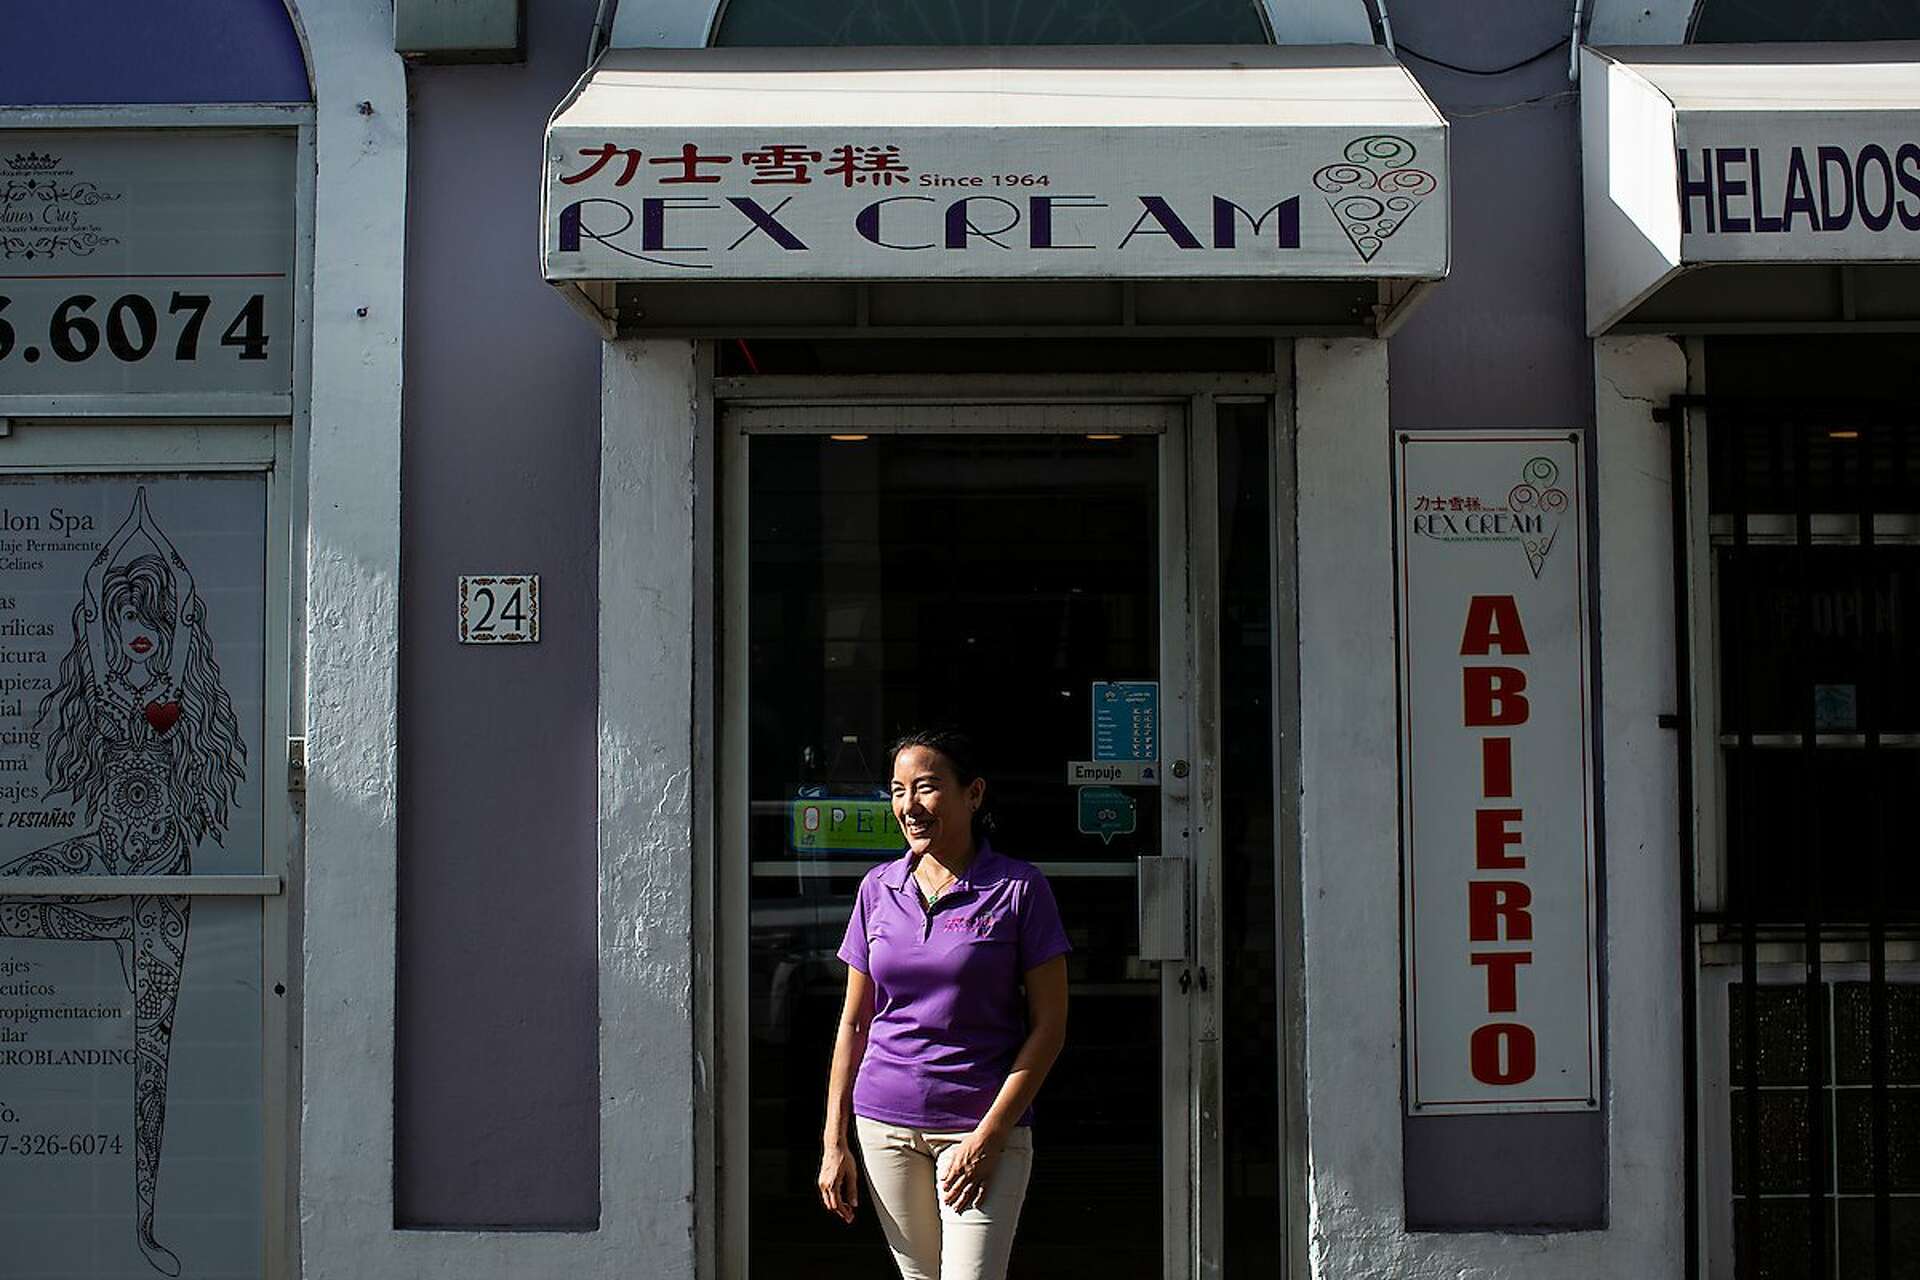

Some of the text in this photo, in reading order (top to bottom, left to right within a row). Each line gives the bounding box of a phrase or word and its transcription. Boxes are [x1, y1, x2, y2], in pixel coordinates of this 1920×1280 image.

[560, 143, 911, 188] 力士雪糕
[919, 174, 1051, 188] Since 1964
[1679, 143, 1920, 233] HELADOS
[559, 195, 1301, 268] REX CREAM
[0, 506, 95, 538] lon Spa
[1414, 513, 1541, 540] REX CREAM
[27, 539, 102, 552] Permanente
[472, 586, 527, 632] 24
[0, 673, 52, 696] pieza
[0, 727, 41, 750] cing
[1075, 765, 1123, 784] Empuje
[8, 807, 76, 829] PESTAÑAS
[1459, 593, 1537, 1087] ABIERTO
